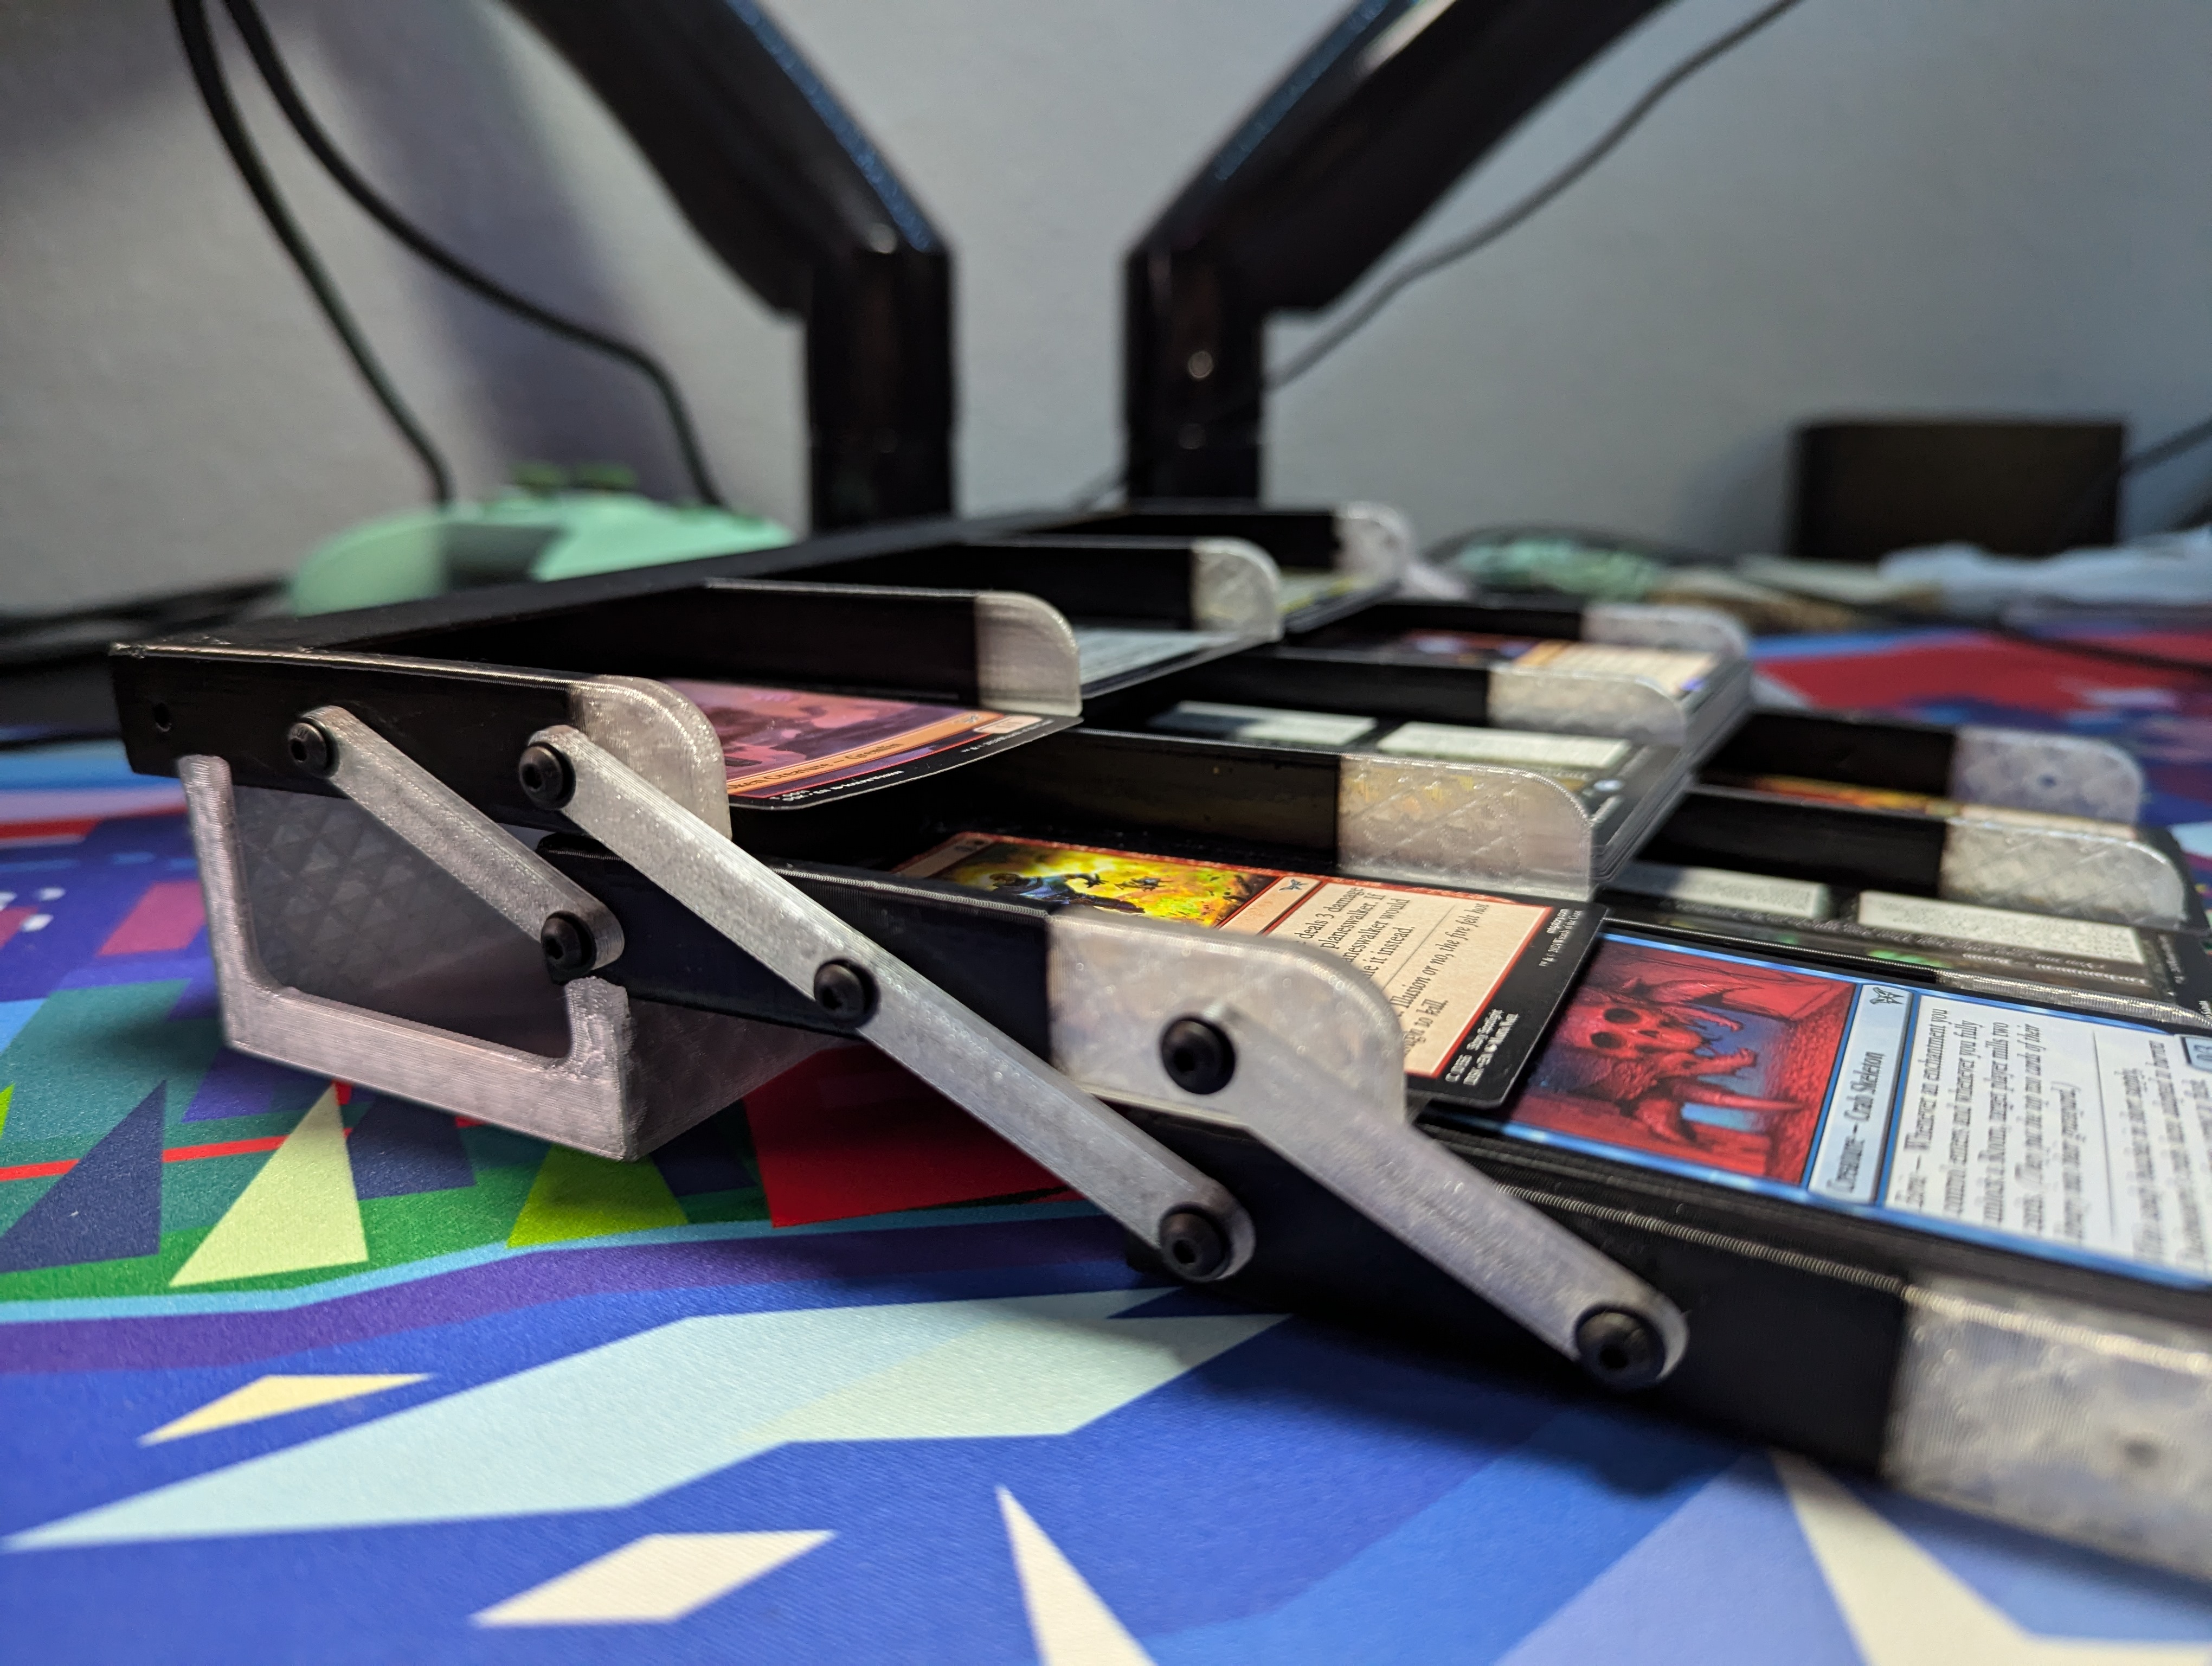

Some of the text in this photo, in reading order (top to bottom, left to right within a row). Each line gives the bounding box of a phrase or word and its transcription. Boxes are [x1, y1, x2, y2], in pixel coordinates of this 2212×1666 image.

[725, 779, 769, 790] oken
[769, 762, 834, 780] Creature
[845, 741, 904, 761] Gremlin
[1294, 920, 1329, 938] deals
[1323, 887, 1365, 912] damage
[1318, 901, 1379, 949] planeswalker.
[1364, 892, 1386, 900] If
[1546, 908, 1569, 933] mtgstory.com
[1341, 920, 1388, 962] aneswalker
[1379, 898, 1410, 919] would
[1369, 926, 1416, 955] instead.
[1362, 956, 1387, 964] it
[1388, 902, 1489, 1008] Illusion or no, the fire felt hot
[1416, 997, 1449, 1016] kill.
[1930, 1008, 1952, 1024] you
[1413, 1016, 1433, 1027] to
[1953, 1019, 1983, 1039] fully
[1992, 1021, 2009, 1037] two
[2016, 1022, 2040, 1042] their
[1917, 1022, 1946, 1081] enchantment
[1958, 1040, 1982, 1059] you
[1984, 1037, 2009, 1060] mills
[2016, 1039, 2047, 1052] of
[1849, 1050, 1886, 1094] Skeleton
[1983, 1060, 2014, 1092] player
[2016, 1052, 2041, 1076] cards
[1920, 1082, 1939, 1096] an
[1947, 1056, 1975, 1102] whenever
[1843, 1094, 1874, 1122] Crab
[1902, 1096, 1937, 1150] Whenever
